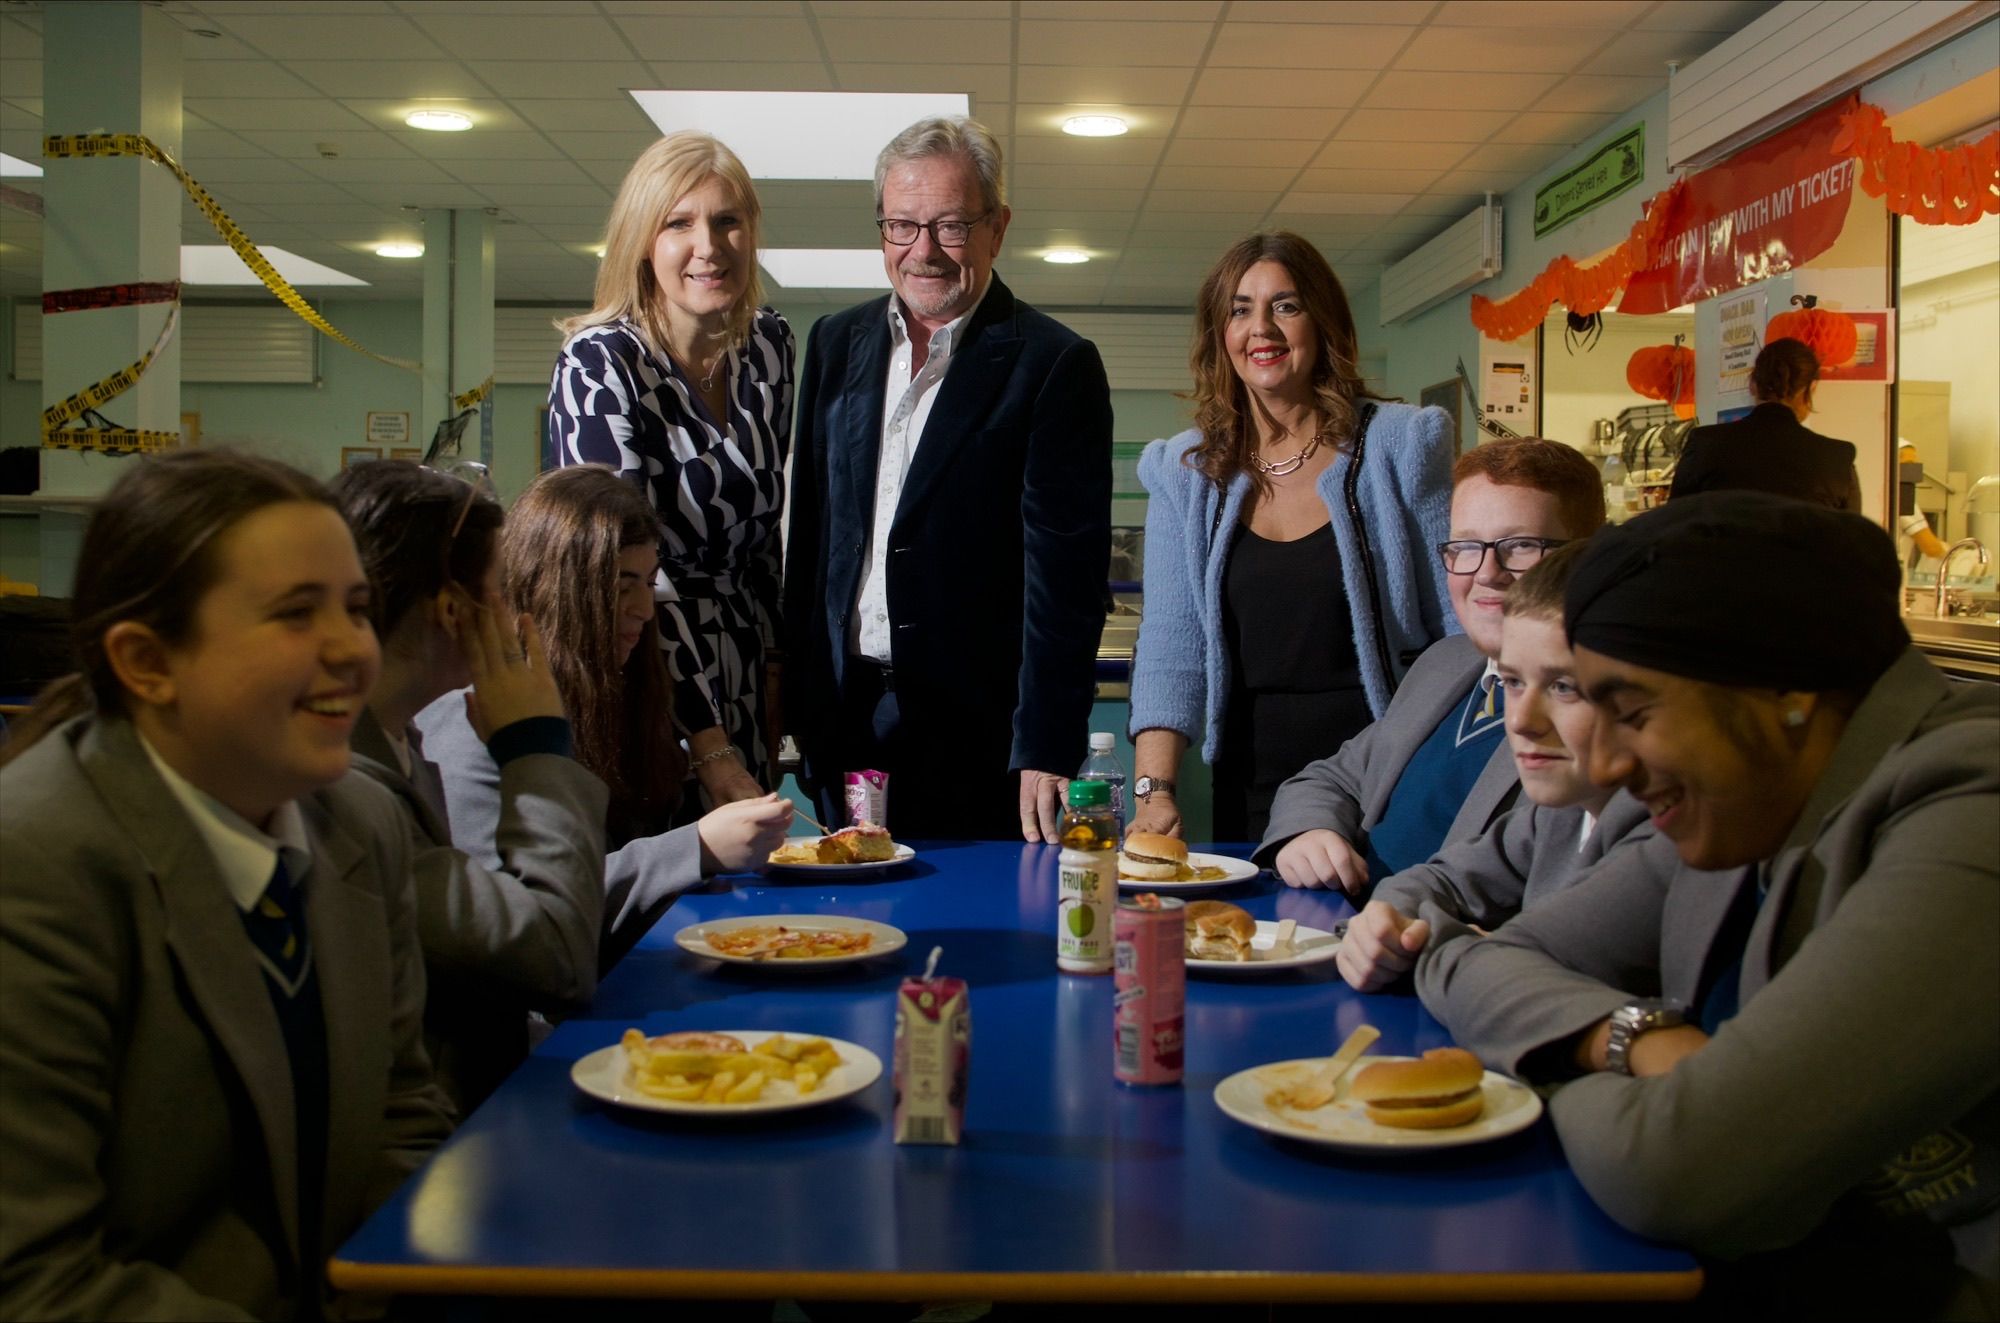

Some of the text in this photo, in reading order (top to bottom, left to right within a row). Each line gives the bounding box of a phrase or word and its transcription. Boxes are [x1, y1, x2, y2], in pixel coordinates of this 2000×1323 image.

[76, 139, 119, 152] CAUTION!
[1674, 227, 1698, 260] CAN
[1734, 196, 1769, 235] WITH
[1771, 183, 1796, 221] MY
[1798, 157, 1856, 209] TICKET?
[68, 397, 88, 413] OUT!
[92, 374, 134, 401] CAUTION!
[48, 433, 70, 444] KEEP
[73, 434, 93, 444] OUT!
[1875, 1163, 1978, 1215] RINITY
